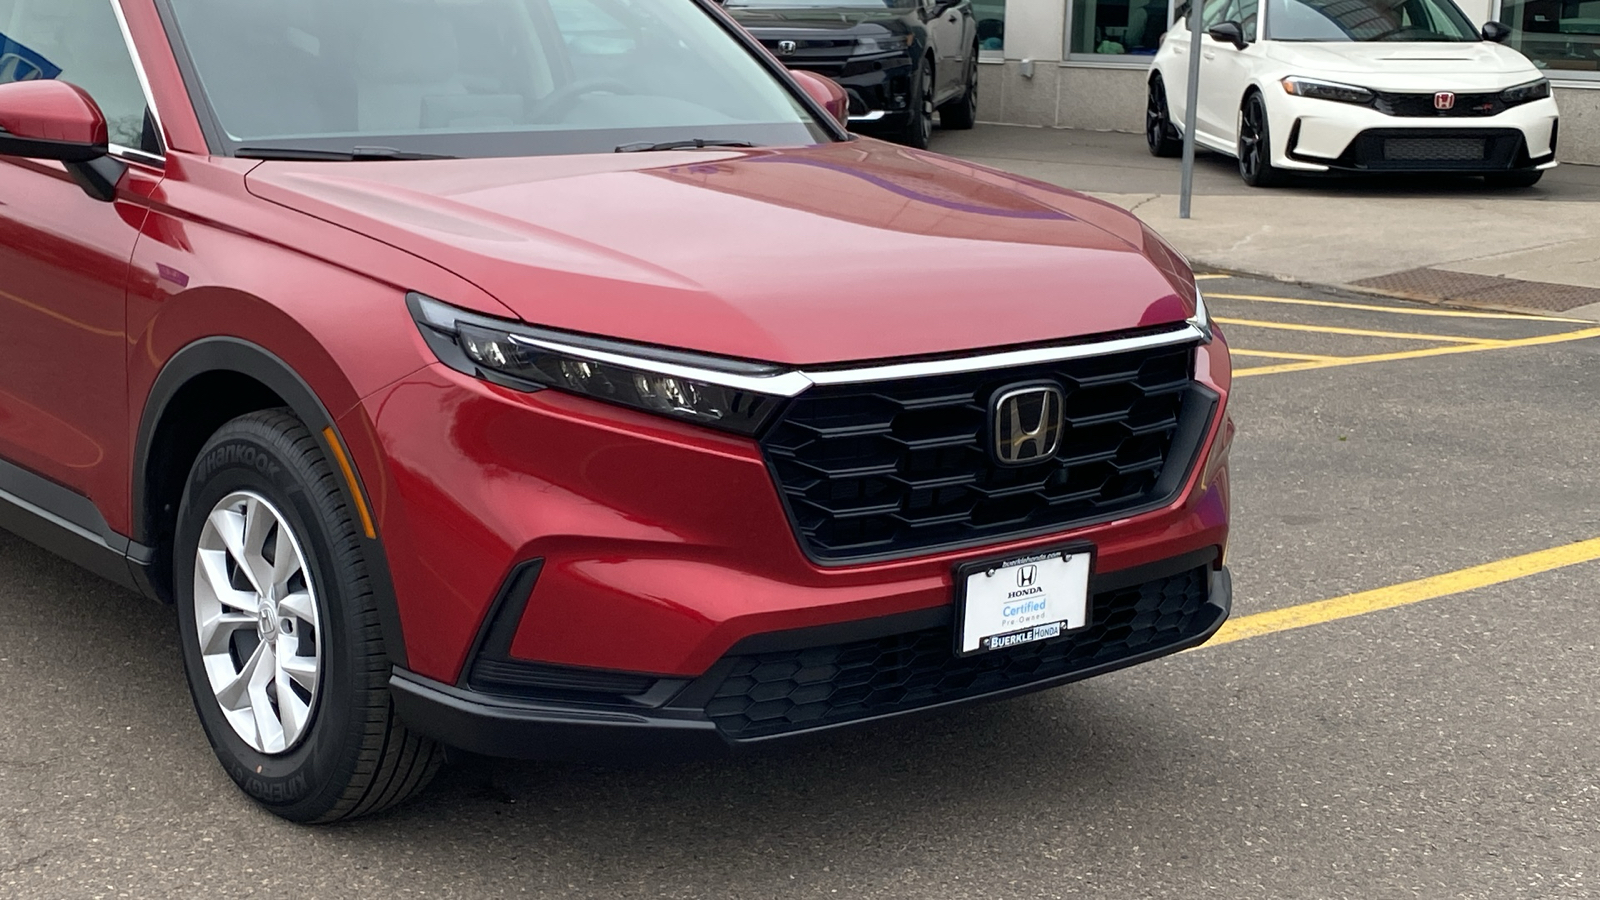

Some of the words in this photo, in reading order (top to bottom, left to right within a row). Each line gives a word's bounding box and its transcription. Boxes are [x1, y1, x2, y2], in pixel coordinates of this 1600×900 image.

[1007, 586, 1043, 599] HONDA
[1003, 598, 1046, 618] Certified
[1001, 612, 1046, 627] Pre-Owned
[991, 631, 1033, 648] BUERKLE
[1034, 626, 1059, 638] HONDA
